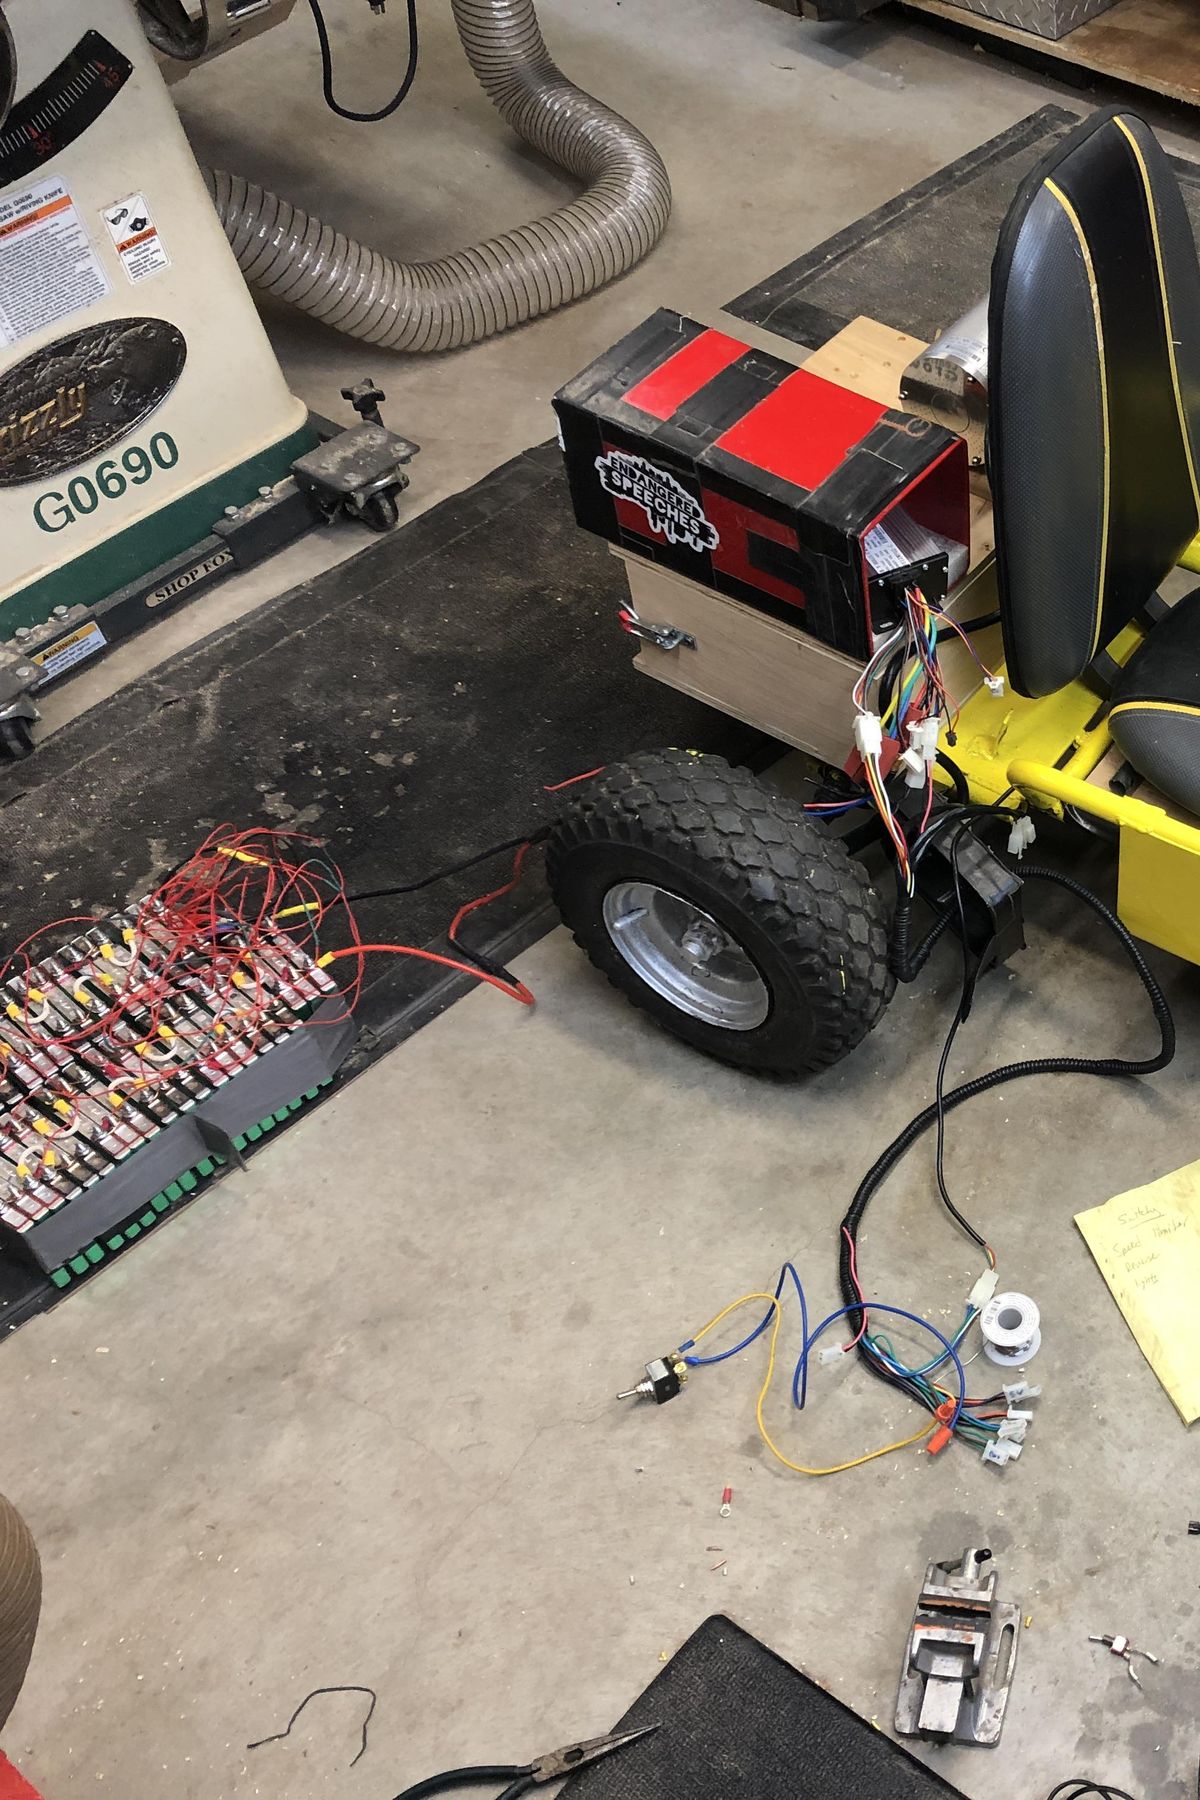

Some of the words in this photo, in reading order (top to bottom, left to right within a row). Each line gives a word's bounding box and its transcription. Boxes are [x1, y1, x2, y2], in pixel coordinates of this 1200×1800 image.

[43, 187, 63, 201] KNIFE
[33, 431, 179, 533] G0690
[610, 456, 702, 520] ENDANGERED
[611, 470, 701, 536] SPEECHES
[155, 569, 199, 602] SHOP
[49, 634, 80, 656] WARNING
